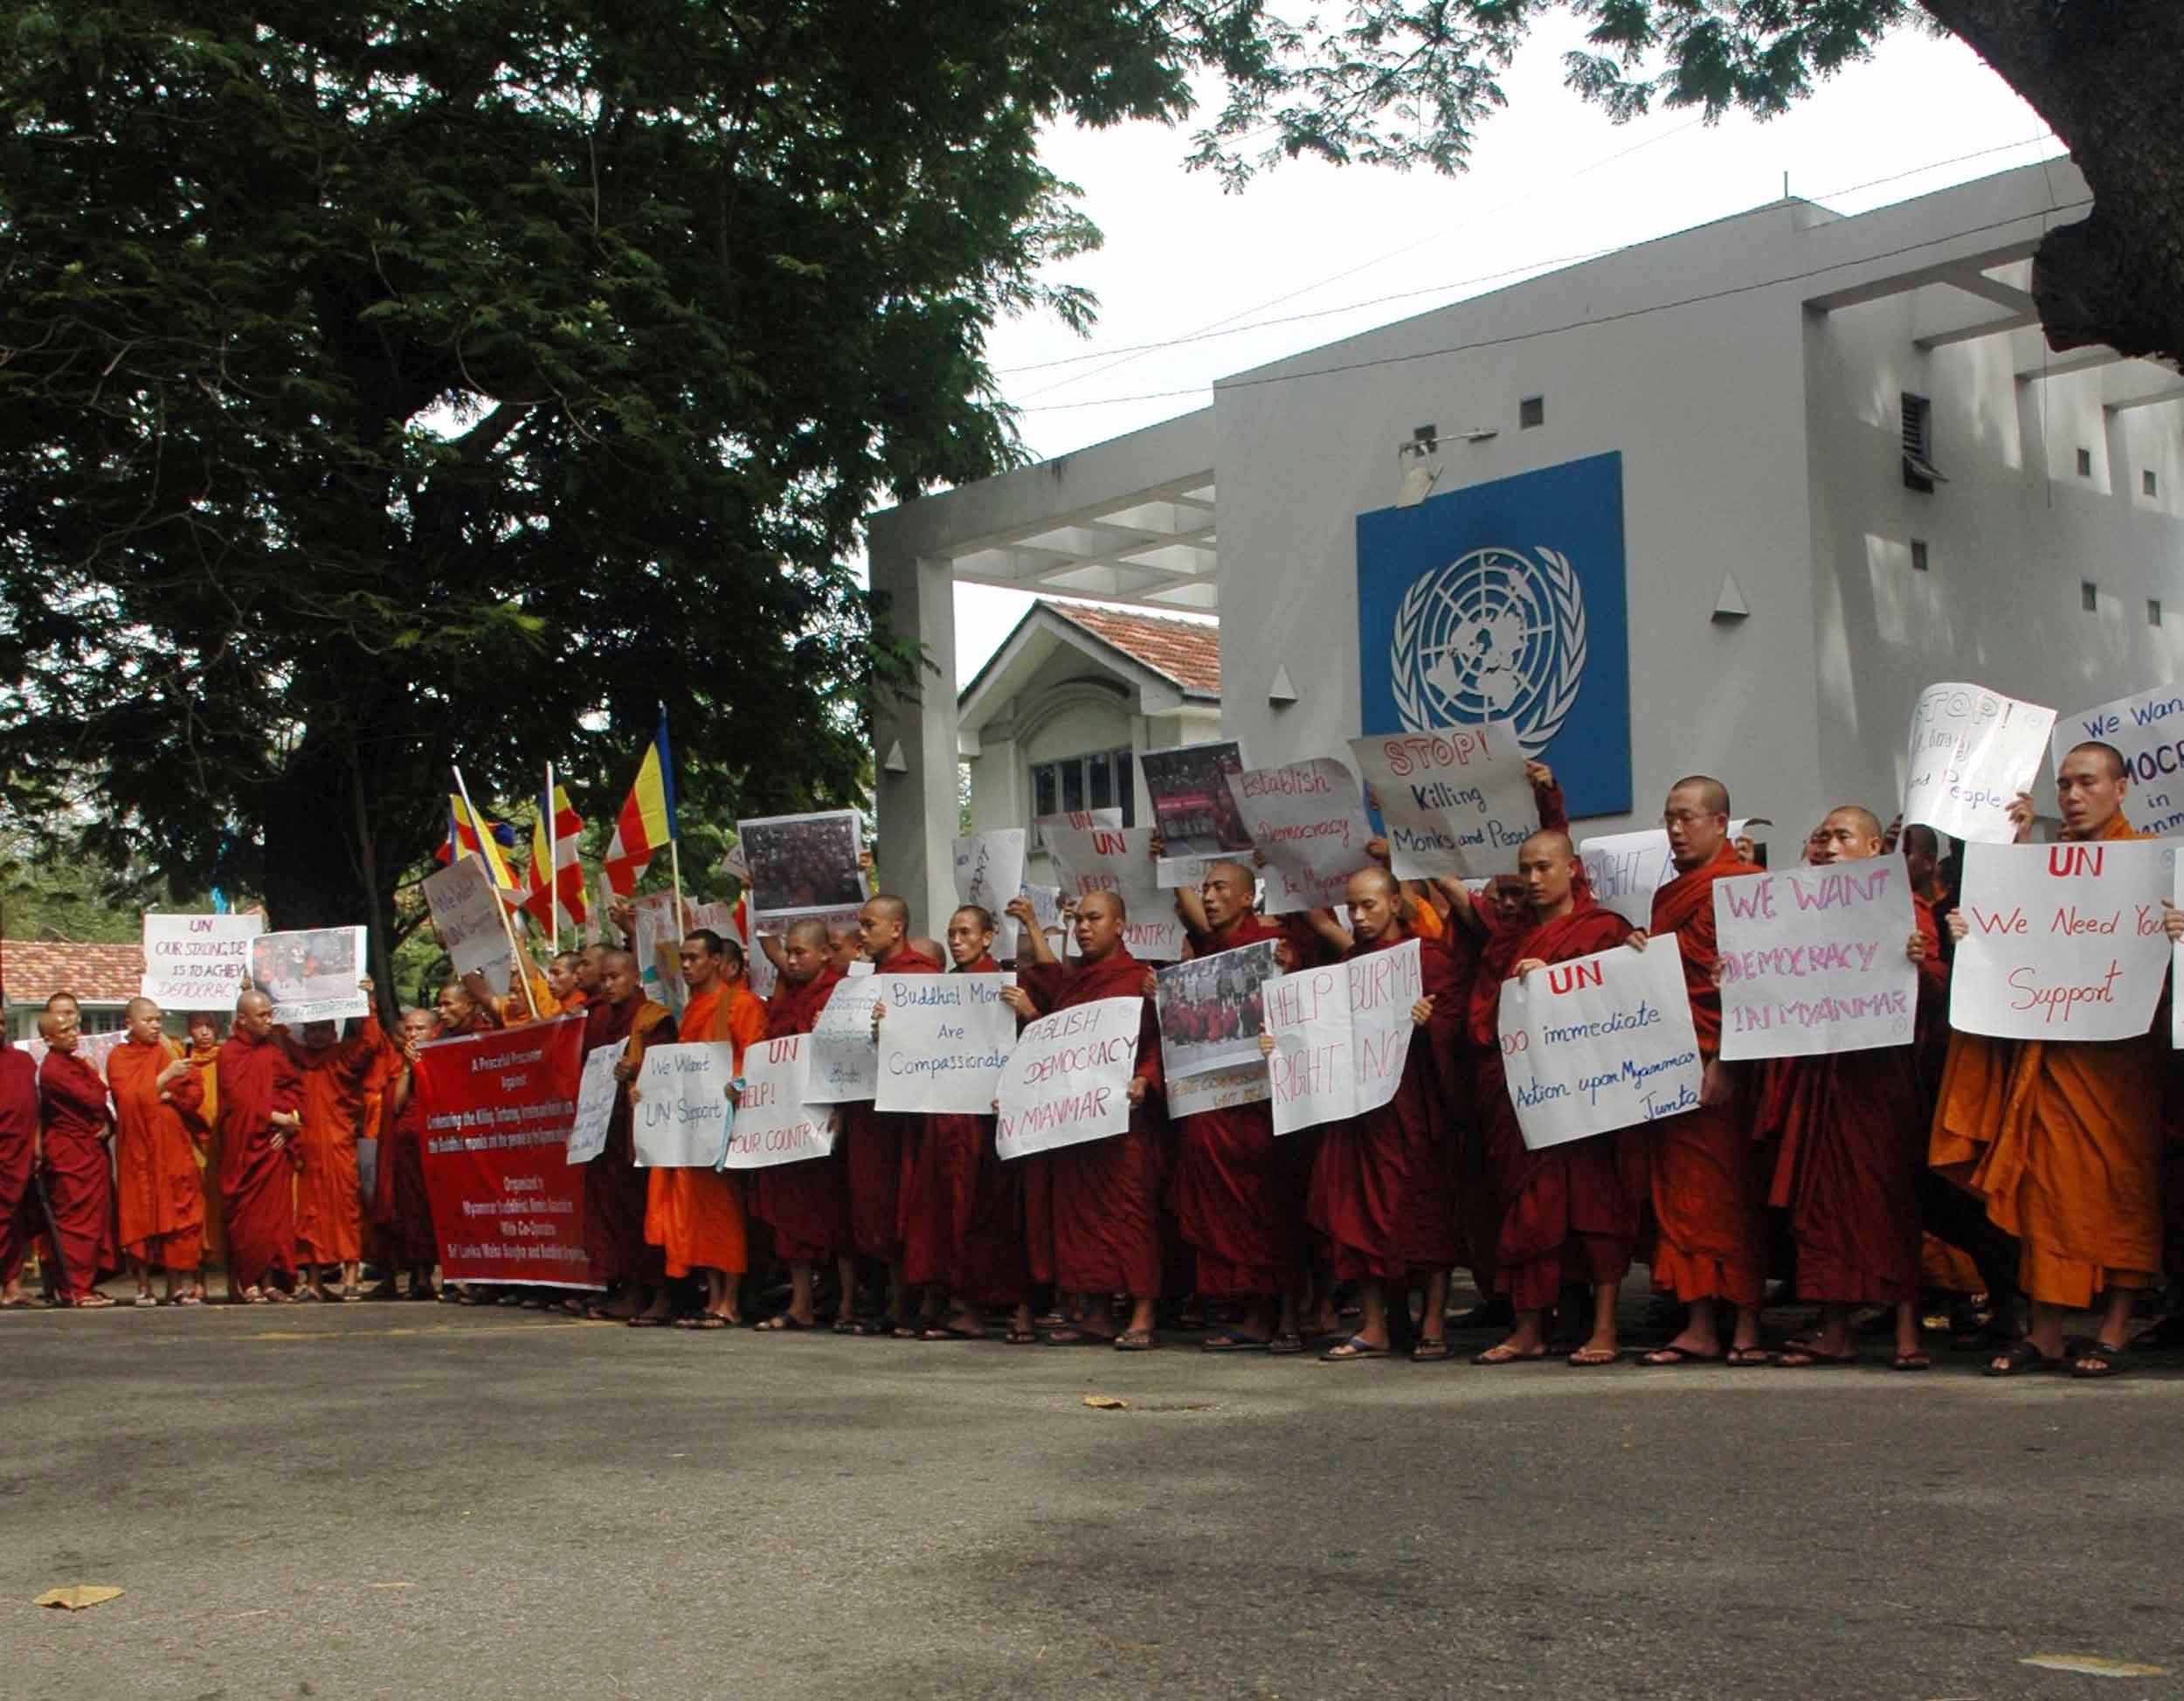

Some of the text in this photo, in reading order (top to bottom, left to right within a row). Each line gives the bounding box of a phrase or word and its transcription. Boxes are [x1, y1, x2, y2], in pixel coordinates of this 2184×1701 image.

[2082, 698, 2184, 739] We Wan
[1383, 729, 1492, 777] STOP!
[1411, 782, 1487, 814] Killing
[2146, 793, 2171, 809] in
[1092, 831, 1128, 855] UN
[1393, 819, 1531, 854] Monks and Peop
[2048, 846, 2104, 877] UN
[1721, 868, 1892, 921] WE WANT
[190, 918, 213, 933] UN
[1971, 906, 2028, 935] We
[2051, 906, 2121, 937] Need
[970, 981, 1003, 1005] Mon
[1267, 950, 1421, 1030] HELP BURMA
[1547, 959, 1605, 996] UN
[2008, 958, 2124, 1024] Support
[936, 1022, 964, 1040] Are
[1025, 1007, 1102, 1043] TABLISH
[1501, 999, 1662, 1055] DO immediate
[768, 1037, 799, 1064] UN
[1023, 1036, 1139, 1085] DEMOCRACY
[1272, 1042, 1344, 1105] RIGHT
[1515, 1051, 1697, 1110] Action upon Myanmar
[645, 1100, 672, 1128] UN
[1019, 1086, 1112, 1134] MYANMAR
[1639, 1083, 1699, 1121] Junta
